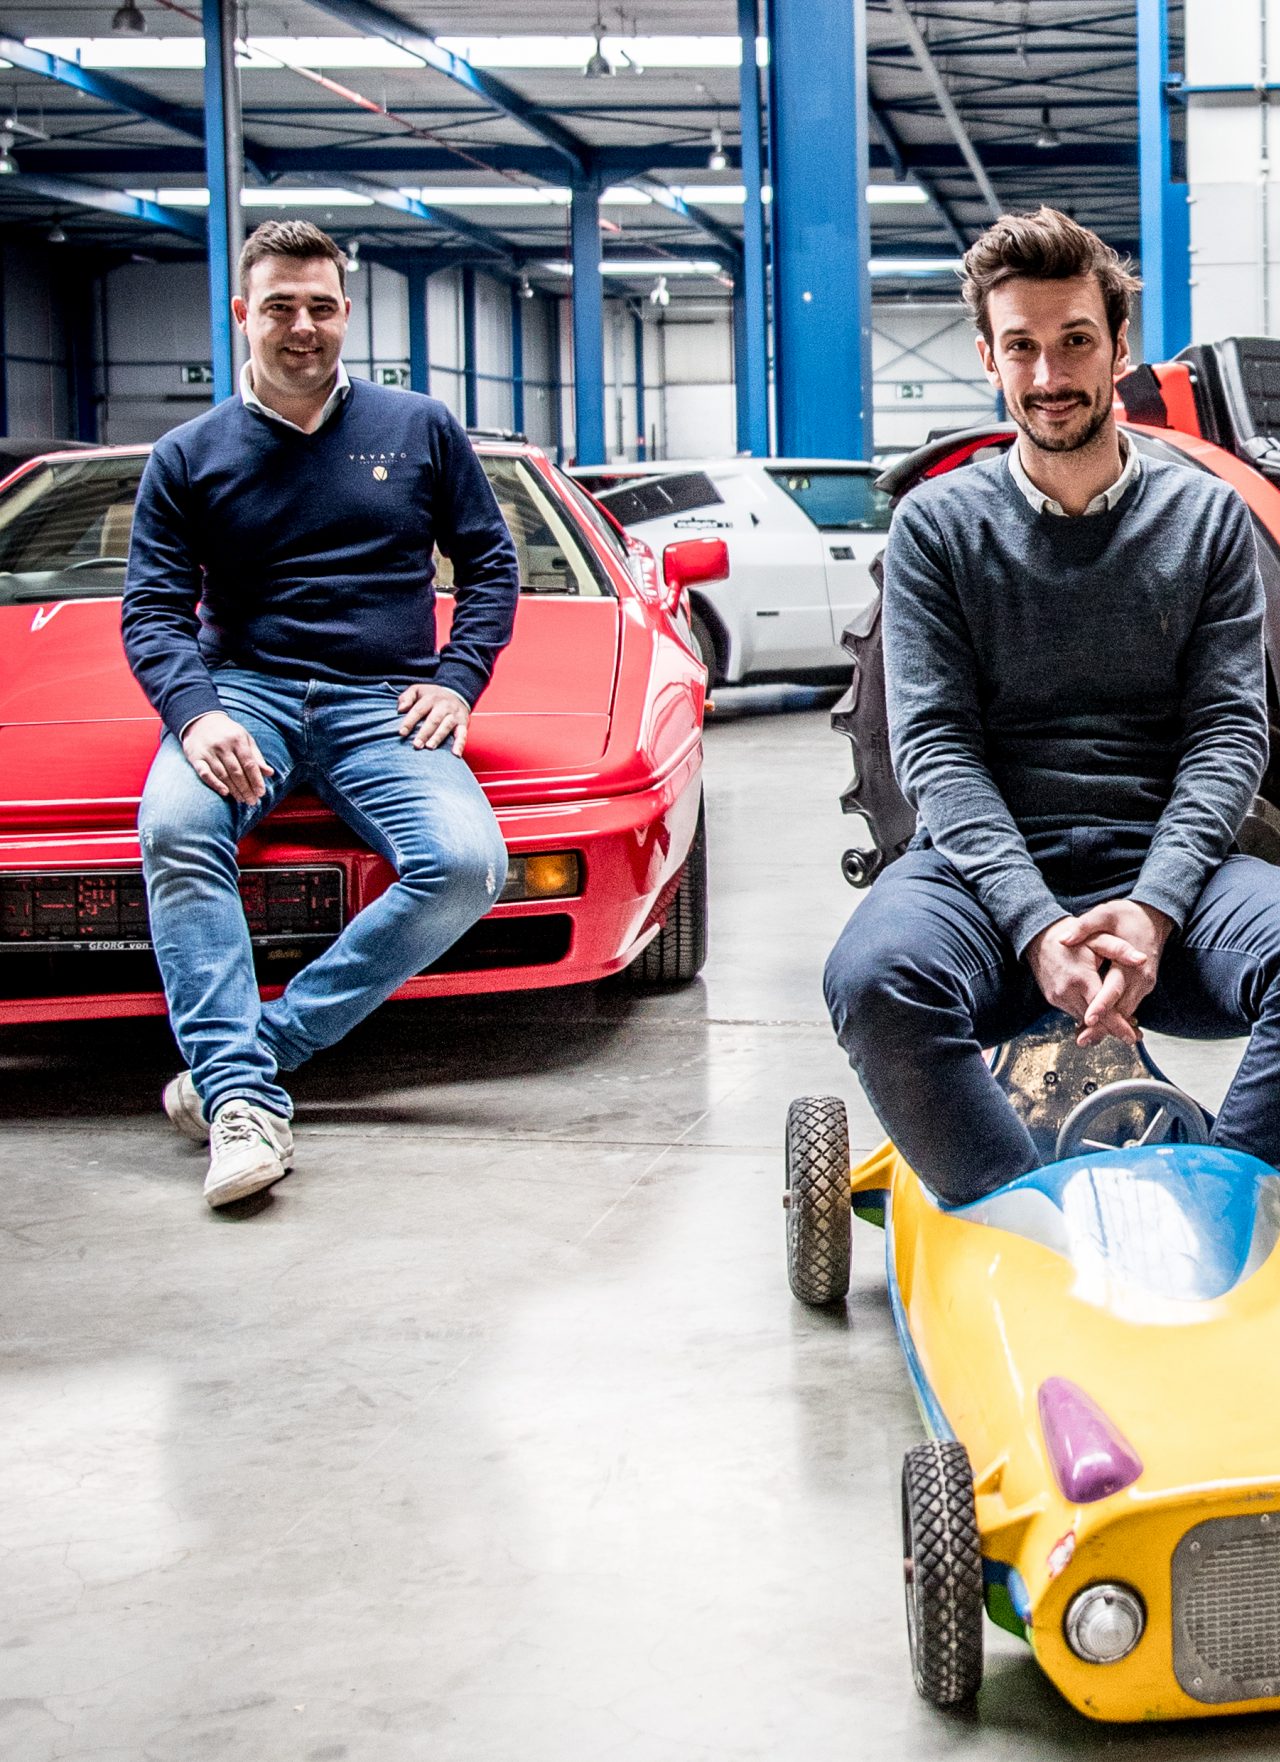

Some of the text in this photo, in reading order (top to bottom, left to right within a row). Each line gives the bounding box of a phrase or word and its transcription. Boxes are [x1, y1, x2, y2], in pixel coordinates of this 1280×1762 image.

[348, 452, 407, 461] VAVATO
[88, 941, 149, 951] GEORG von
